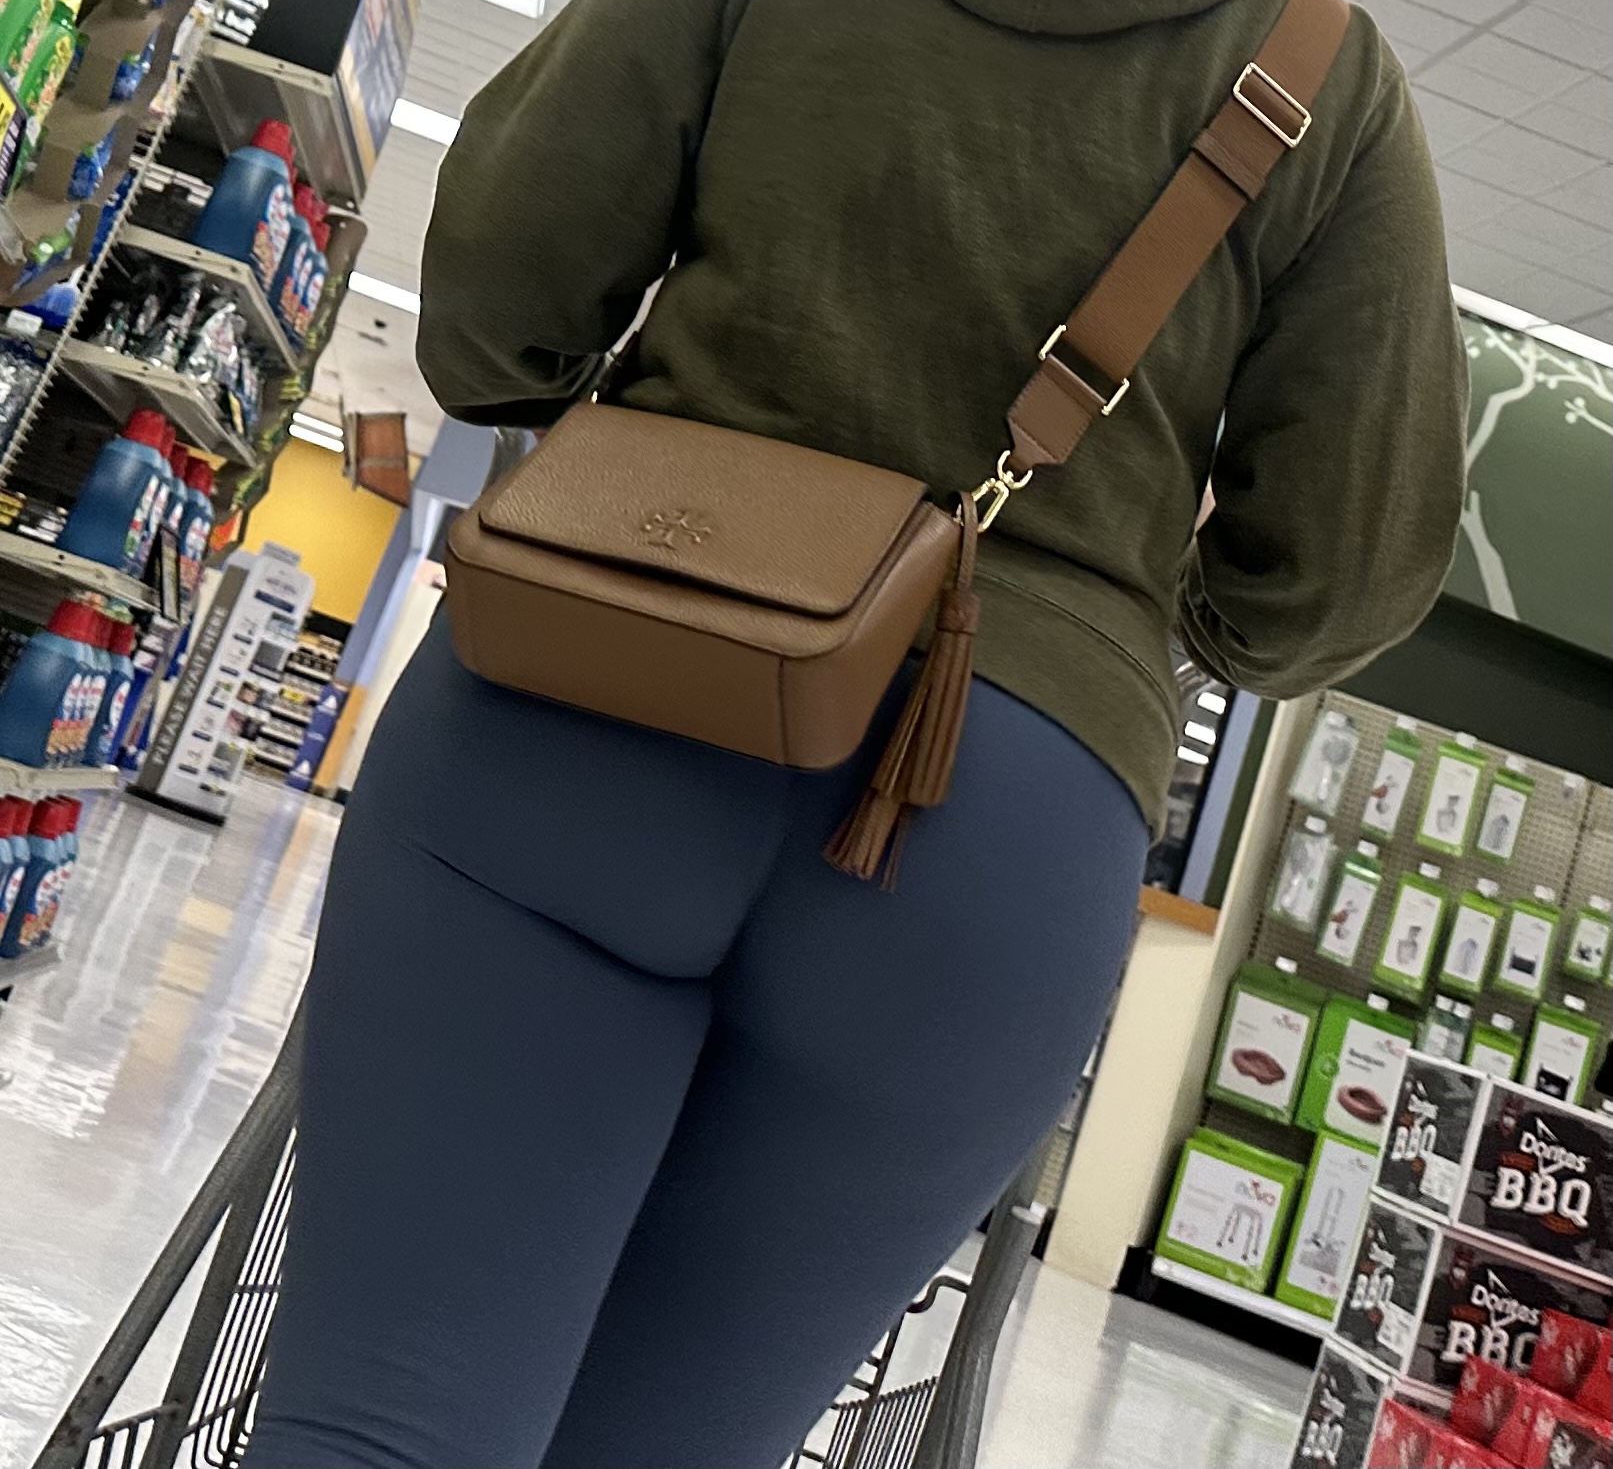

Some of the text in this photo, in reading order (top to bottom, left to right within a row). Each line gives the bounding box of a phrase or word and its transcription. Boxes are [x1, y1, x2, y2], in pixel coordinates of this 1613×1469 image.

[153, 699, 188, 764] PLEASE
[1519, 1128, 1590, 1174] Doritos
[1490, 1166, 1592, 1229] BBQ
